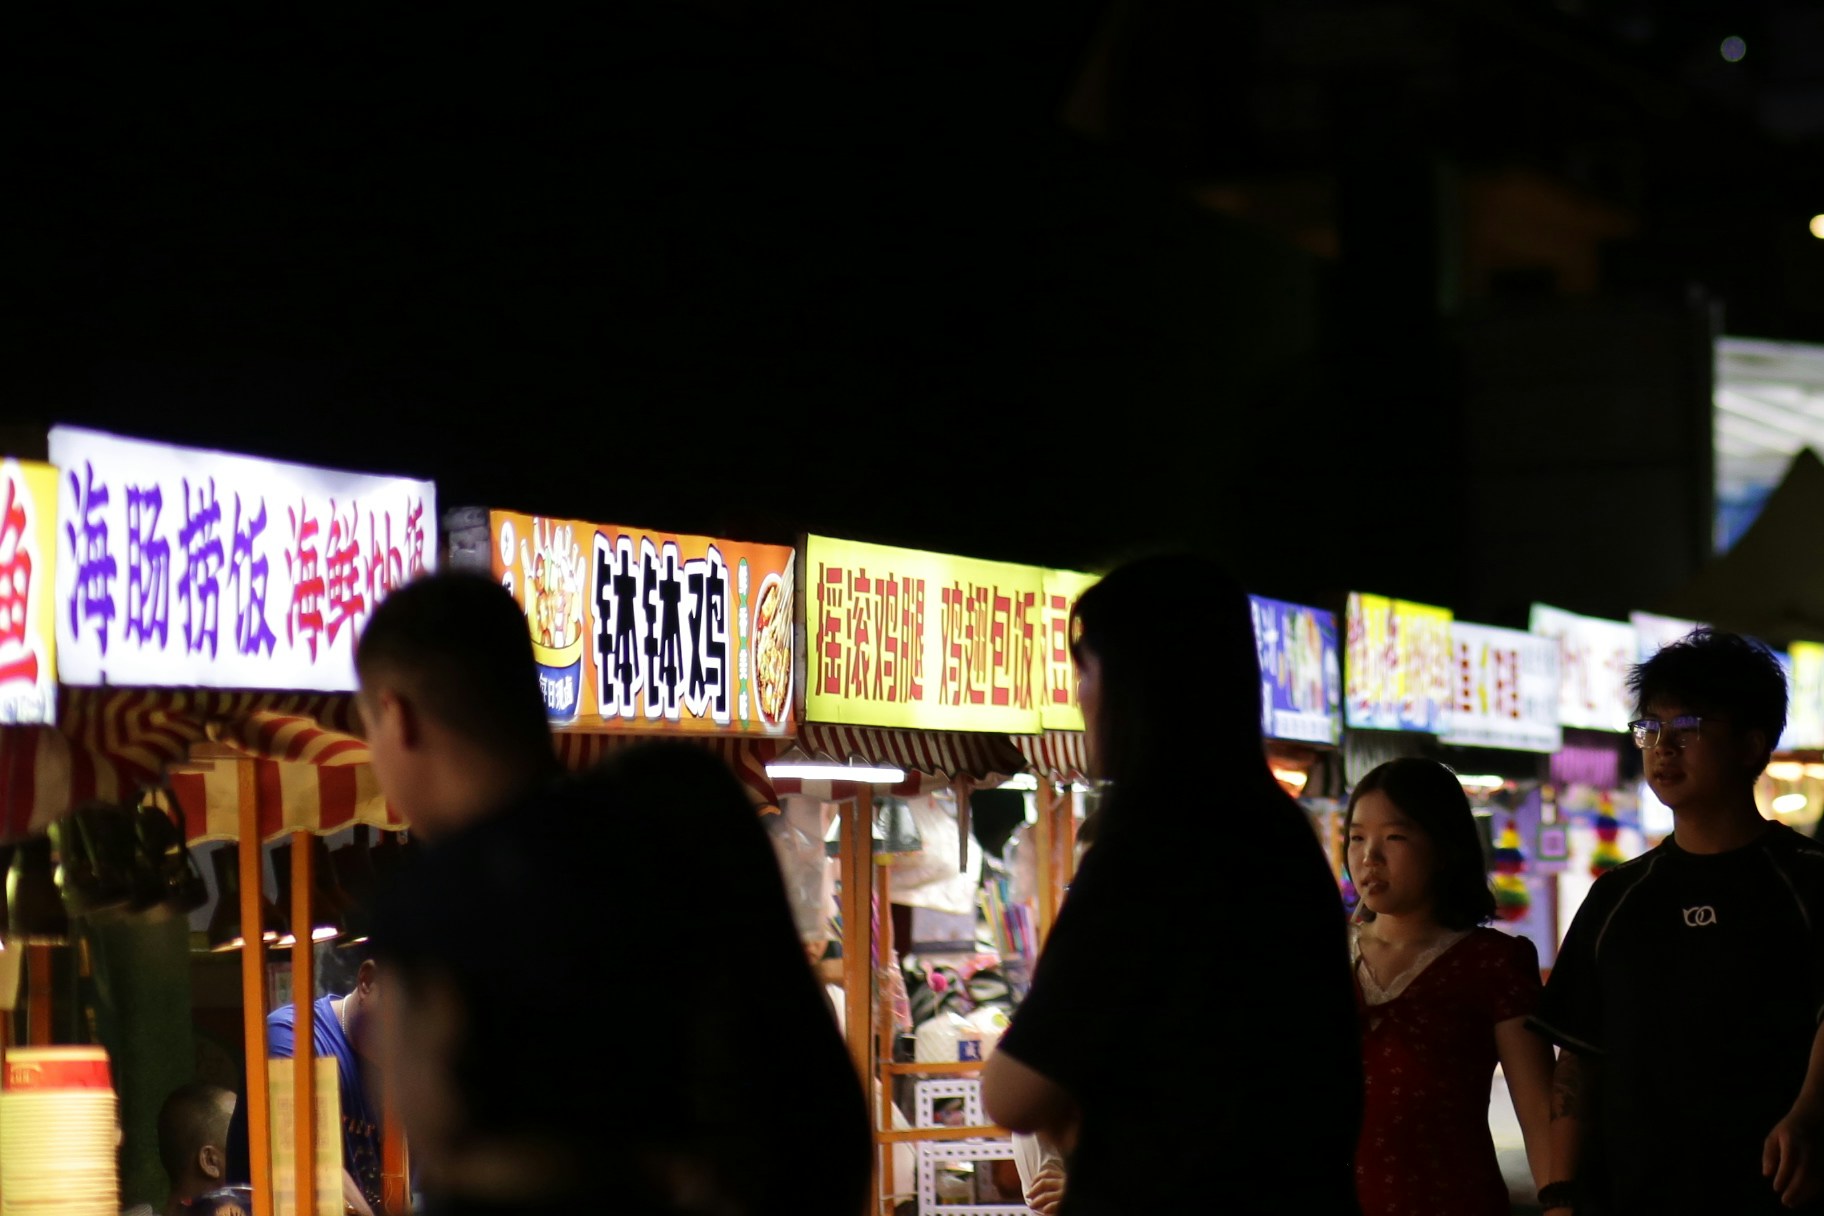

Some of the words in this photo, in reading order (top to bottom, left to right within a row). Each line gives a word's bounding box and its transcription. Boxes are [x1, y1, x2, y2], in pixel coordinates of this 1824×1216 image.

[66, 460, 276, 661] 海肠捞饭
[593, 537, 729, 718] 钵钵鸡
[815, 562, 925, 703] 摇滚鸡腿
[939, 580, 1034, 710] 鸡翅包饭
